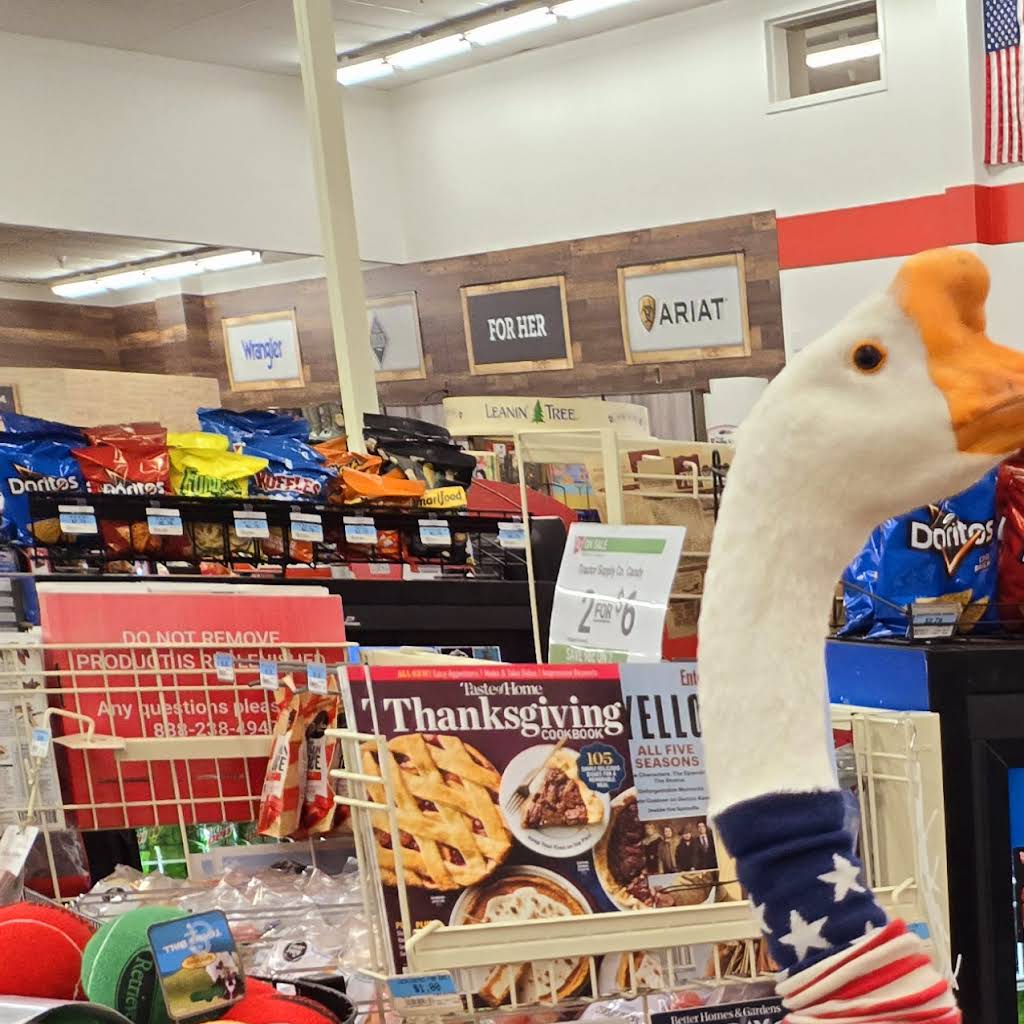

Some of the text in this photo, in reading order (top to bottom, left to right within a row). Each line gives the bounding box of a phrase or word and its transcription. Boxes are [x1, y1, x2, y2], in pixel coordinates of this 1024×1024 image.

[659, 297, 724, 326] ARIAT
[488, 313, 547, 342] FOR HER
[241, 337, 283, 370] Wrangler
[544, 404, 577, 421] TREE
[8, 476, 79, 495] Doritos
[414, 491, 462, 507] martfood
[910, 516, 993, 551] Doritos
[578, 589, 596, 633] 2
[594, 602, 613, 620] FOR
[121, 630, 280, 645] DO NOT REMOVE
[77, 654, 171, 669] PRODUCT
[177, 654, 196, 669] IS
[97, 699, 133, 718] Any
[139, 699, 229, 716] questions
[383, 696, 625, 738] Thanksgiving
[541, 728, 605, 741] COOKBOOK
[638, 743, 695, 756] ALL FIVE
[586, 752, 614, 766] 105
[635, 755, 700, 769] SEASONS
[700, 1010, 734, 1023] Homes
[734, 1008, 744, 1018] &
[742, 1005, 782, 1018] Gardens
